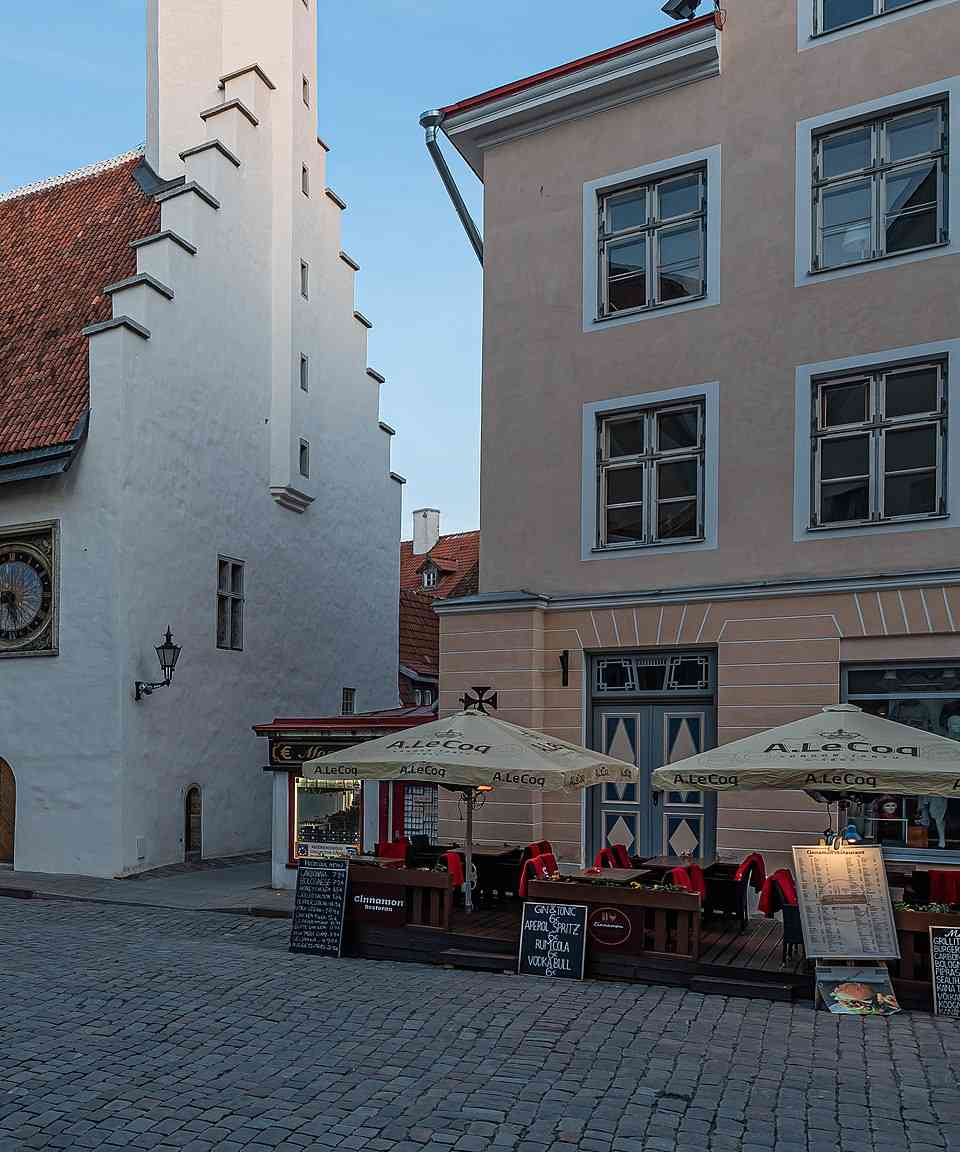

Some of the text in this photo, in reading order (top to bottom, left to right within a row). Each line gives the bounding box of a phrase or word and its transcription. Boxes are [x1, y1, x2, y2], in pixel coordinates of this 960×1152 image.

[525, 920, 581, 935] APEROL SPRITZ
[527, 955, 572, 970] VODKA BULL
